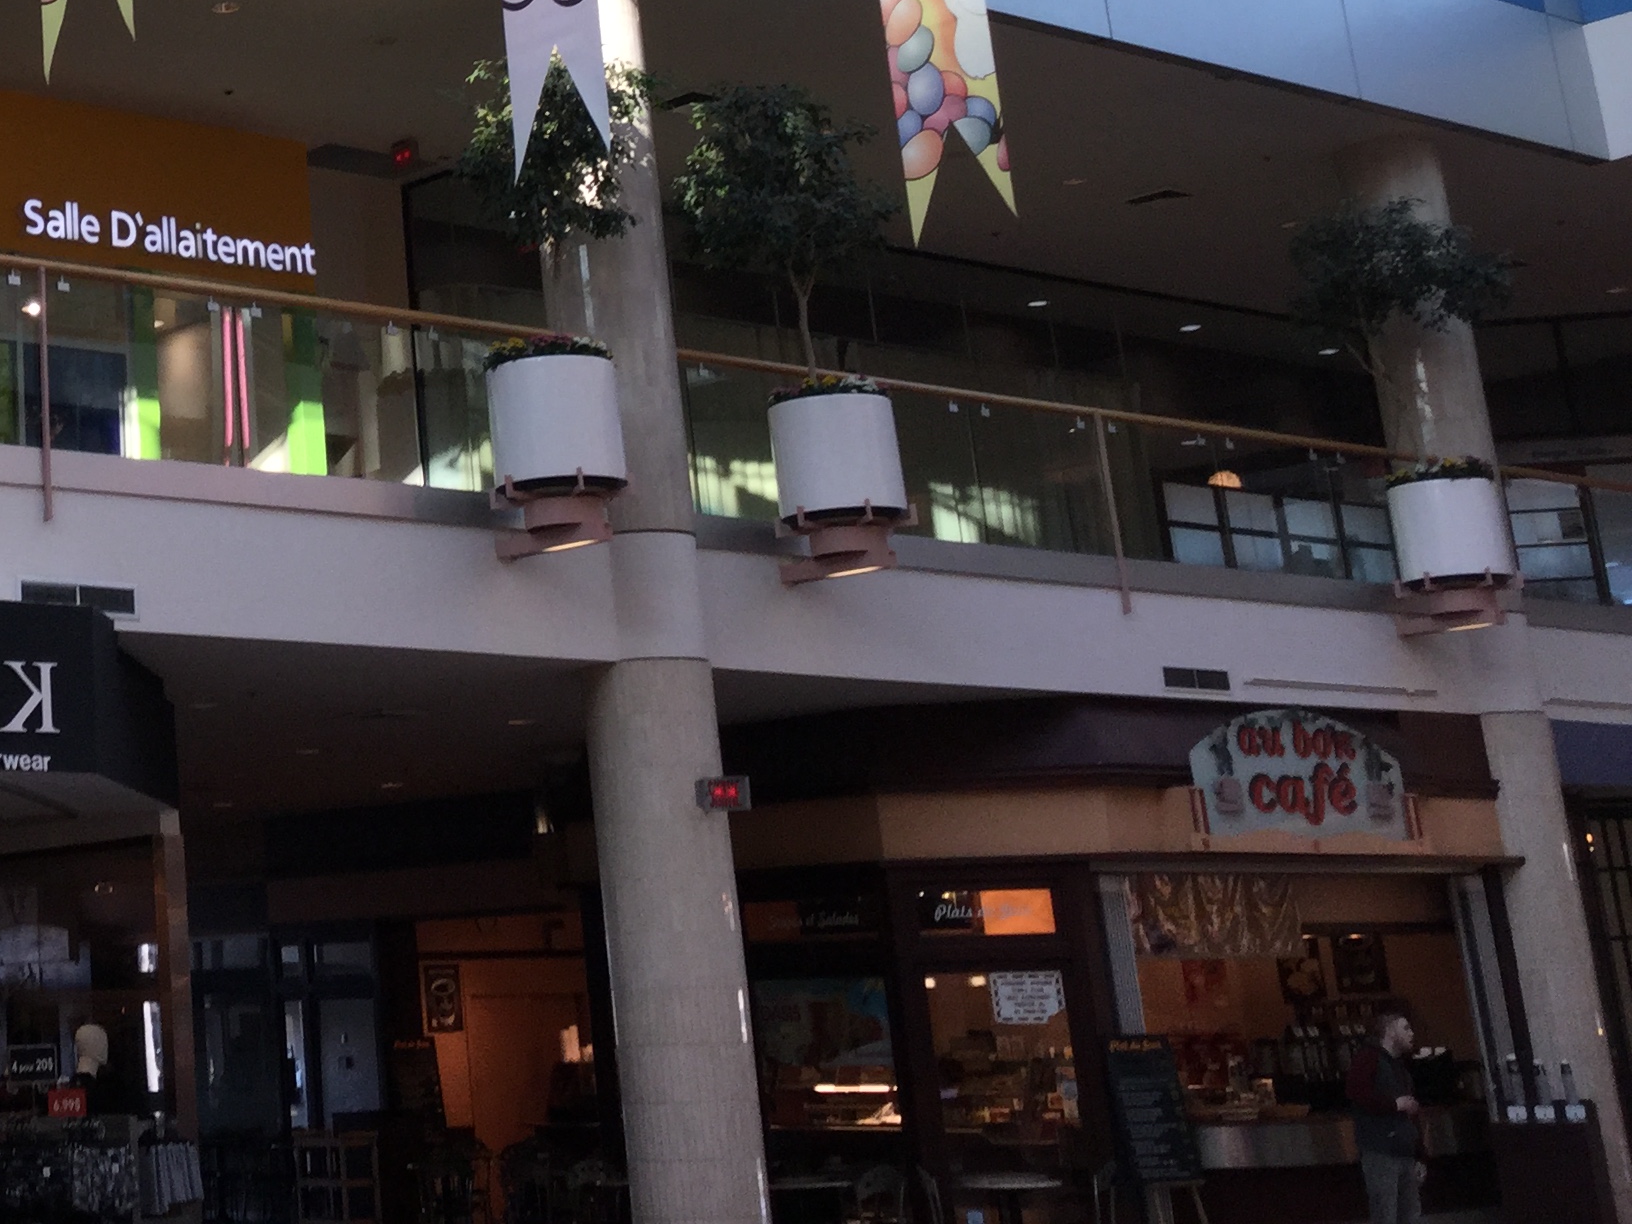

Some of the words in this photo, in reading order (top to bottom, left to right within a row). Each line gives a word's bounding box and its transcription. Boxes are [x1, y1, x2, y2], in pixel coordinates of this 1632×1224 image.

[23, 198, 101, 244] Salle
[110, 209, 317, 276] D'allaitement
[1237, 725, 1286, 759] au
[1292, 719, 1357, 761] bon
[1248, 761, 1358, 826] café
[933, 904, 974, 922] Plats
